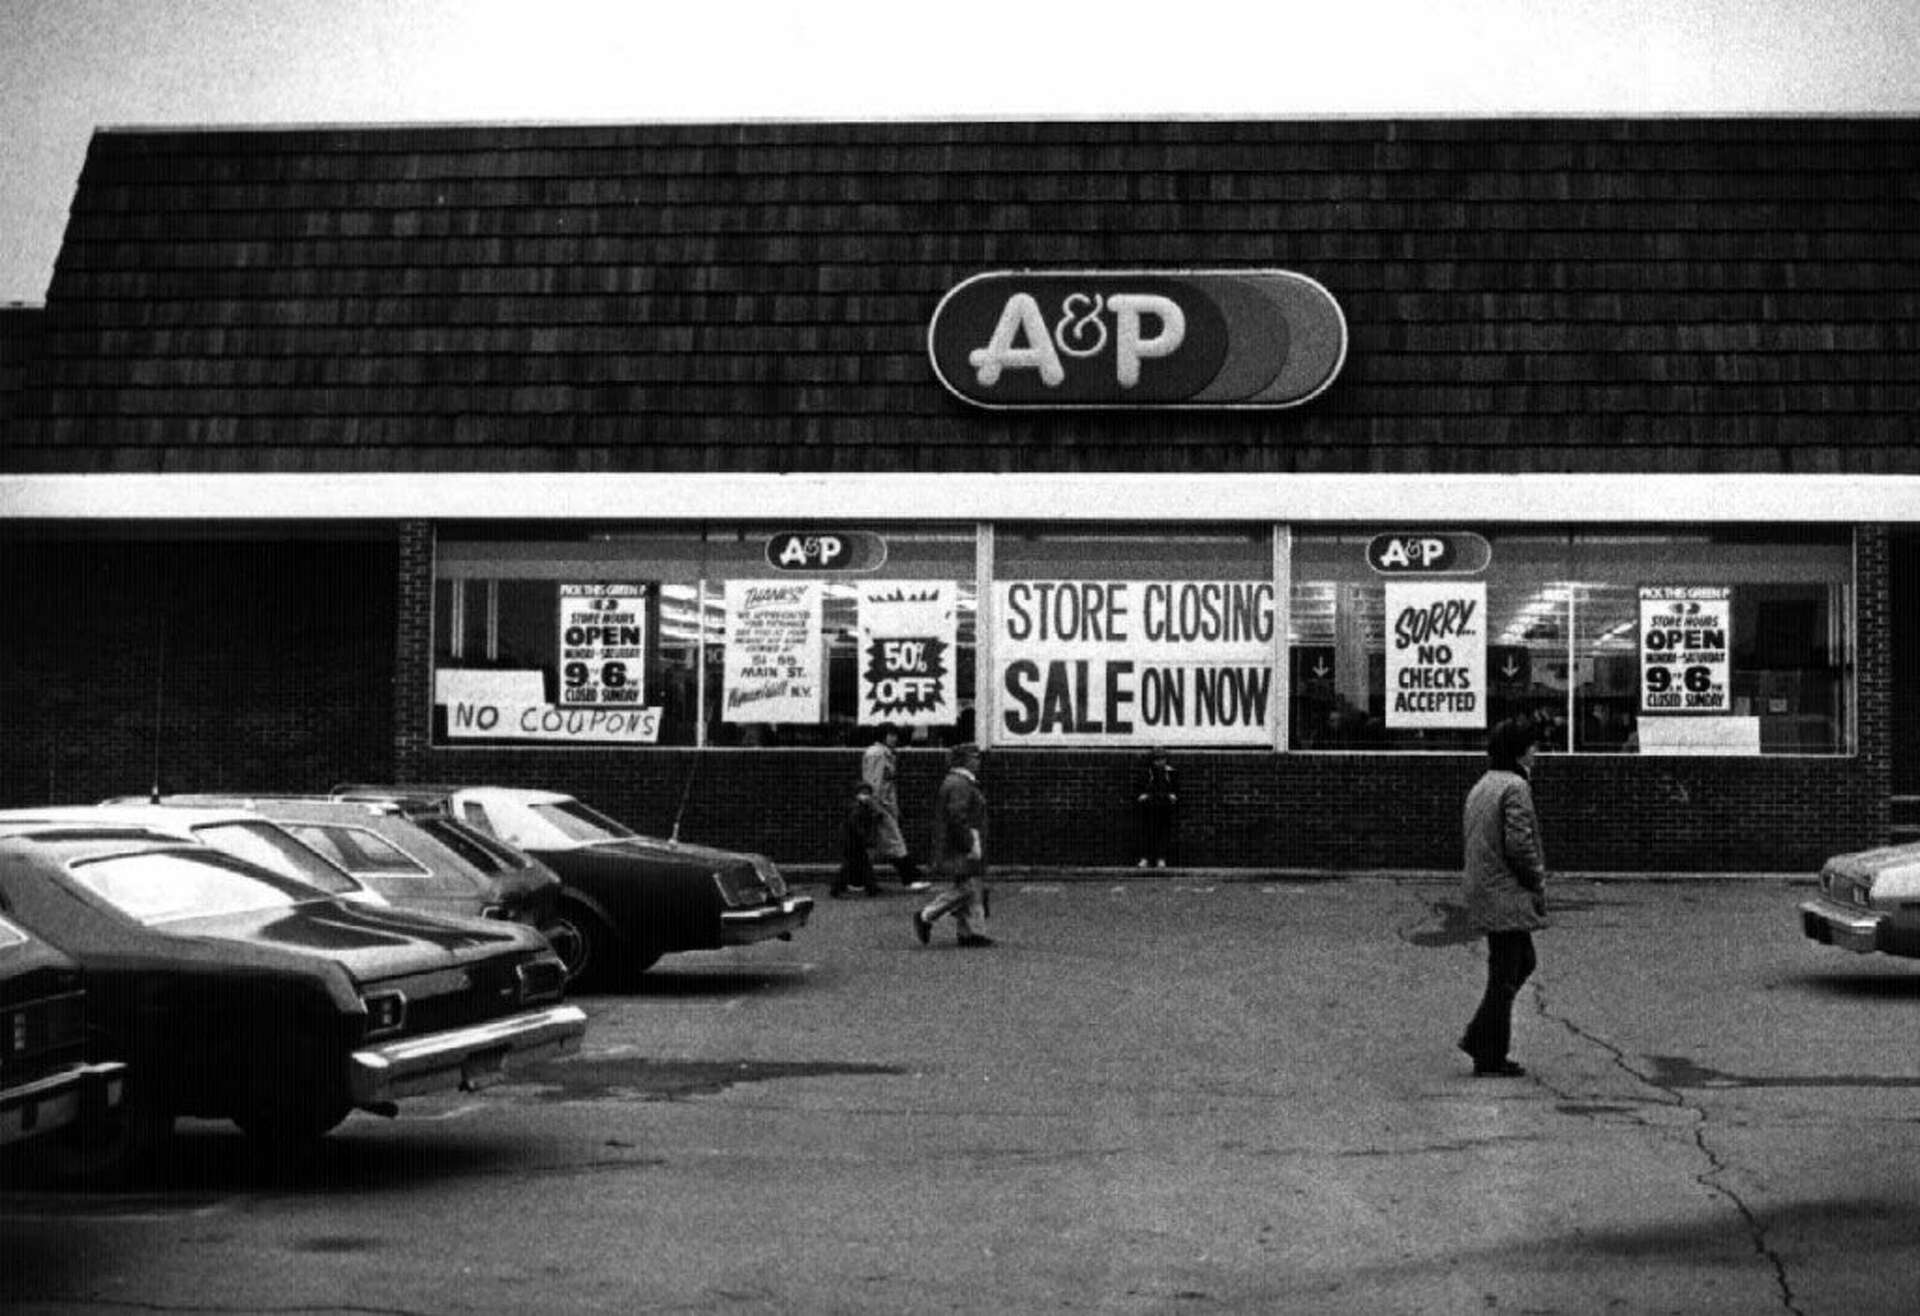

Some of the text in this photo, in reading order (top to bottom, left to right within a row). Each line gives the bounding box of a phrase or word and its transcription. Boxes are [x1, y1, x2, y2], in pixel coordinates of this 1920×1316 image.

[969, 293, 1186, 387] A&P
[779, 536, 842, 565] A&P
[1380, 538, 1445, 567] A&P
[1007, 583, 1274, 641] STORE CLOSING
[565, 626, 640, 646] OPEN
[1646, 629, 1725, 650] OPEN
[884, 642, 926, 671] 50%
[1418, 645, 1453, 665] NO
[565, 661, 626, 688] 9 6
[741, 667, 777, 678] MAIN
[1398, 667, 1471, 689] CHECKS
[1646, 666, 1671, 692] 9
[1684, 666, 1711, 692] 6
[877, 678, 937, 704] OFF
[1004, 660, 1272, 734] SALE ON NOW
[1395, 692, 1476, 712] ACCEPTED
[456, 702, 655, 736] NO COUPONS
